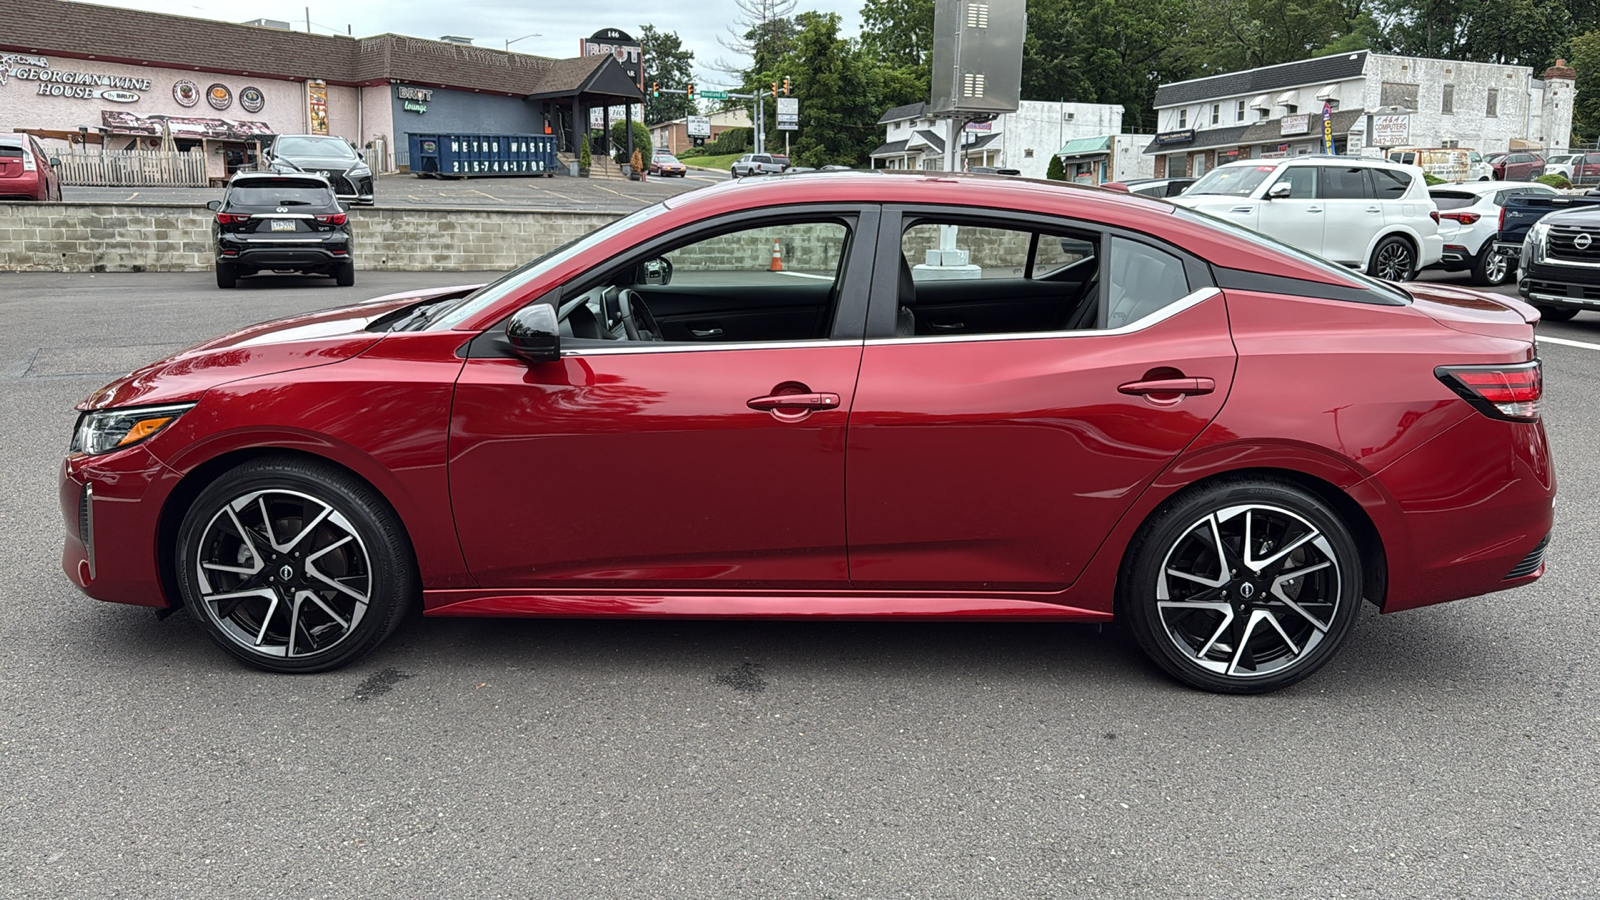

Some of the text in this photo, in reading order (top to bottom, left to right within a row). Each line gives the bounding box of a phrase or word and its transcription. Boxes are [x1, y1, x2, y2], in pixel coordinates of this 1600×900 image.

[16, 68, 152, 91] GEORGIAN WINE
[38, 83, 94, 99] HOUSE
[398, 86, 433, 101] BRUT
[1375, 123, 1407, 131] COMPUTERS
[1373, 137, 1407, 145] 942-9700
[451, 142, 551, 153] METRO WASTE
[453, 161, 544, 172] 215-744-1700
